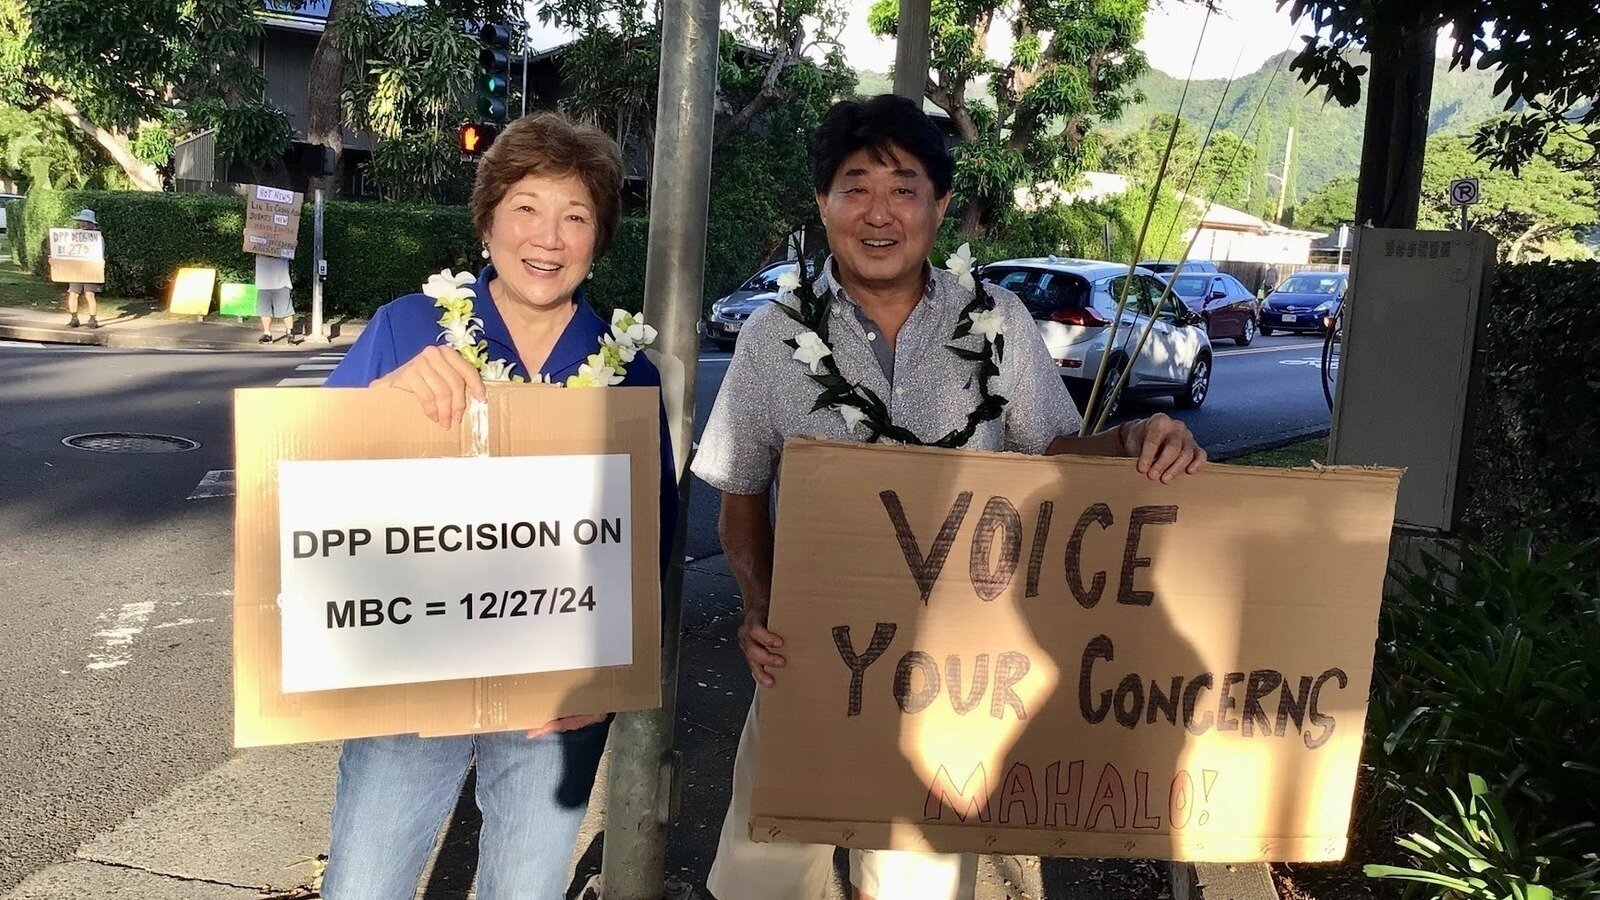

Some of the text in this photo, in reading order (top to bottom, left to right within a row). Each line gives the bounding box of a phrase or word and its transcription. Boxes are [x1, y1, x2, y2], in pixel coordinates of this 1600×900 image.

[260, 188, 291, 202] HOT NEWS
[53, 231, 98, 243] DPP DECISION
[293, 517, 622, 559] DPP DECISION ON
[878, 489, 1180, 609] VOICE
[326, 585, 596, 629] MBC = 12/27/24
[831, 622, 1348, 750] YOUR CONCERNS
[923, 761, 1218, 830] MAHALO!
